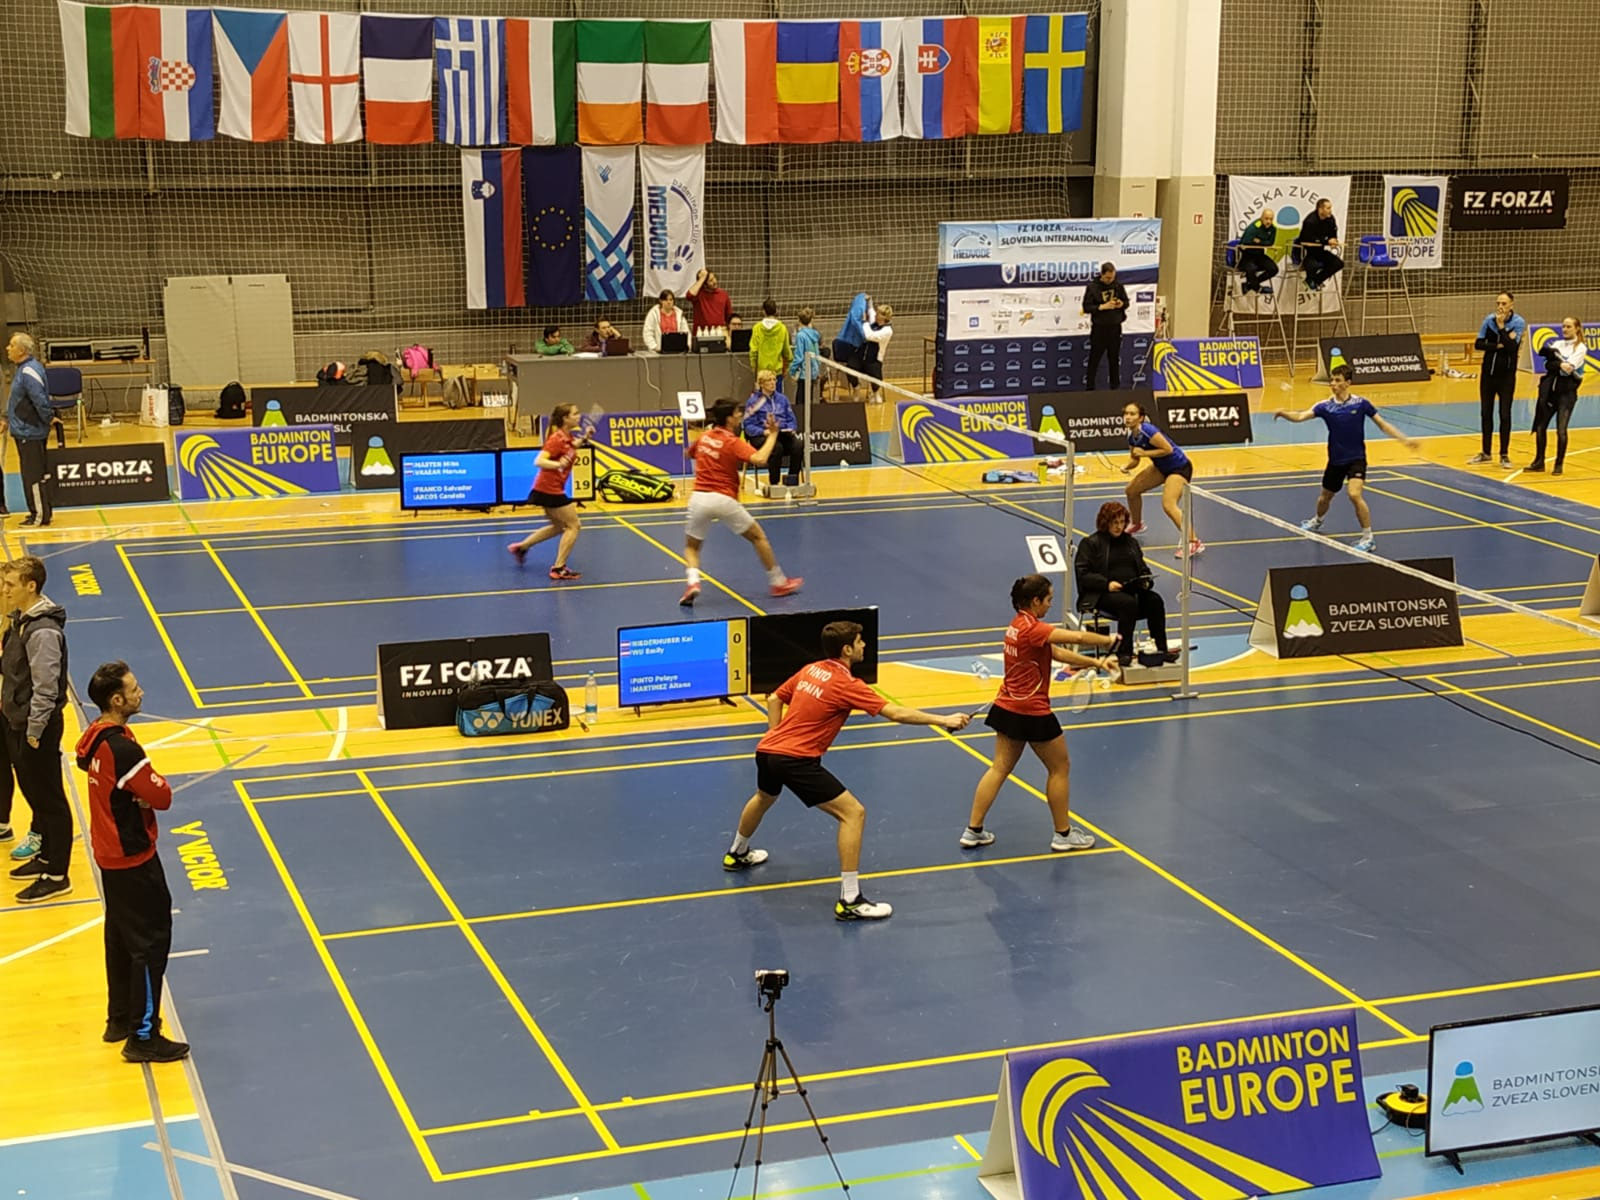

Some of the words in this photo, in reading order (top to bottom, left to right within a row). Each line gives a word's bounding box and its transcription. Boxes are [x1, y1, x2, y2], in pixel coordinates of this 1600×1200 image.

[1289, 185, 1319, 205] ZVE
[1464, 191, 1485, 208] FZ
[1491, 190, 1553, 208] FORZA
[647, 185, 668, 270] MEDVODE
[1018, 224, 1029, 233] FZ
[1031, 223, 1061, 232] FORZA
[1001, 235, 1042, 245] SLOVENIA
[1044, 234, 1110, 243] INTERNATIONAL
[1391, 245, 1435, 258] EUROPE
[1020, 261, 1100, 283] MEDVODE
[1199, 341, 1257, 352] BADMINTON
[1200, 351, 1258, 367] EUROPE
[1352, 355, 1420, 366] BADMINTONSKA
[1355, 366, 1381, 374] ZVEZA
[685, 398, 699, 414] 5
[1168, 409, 1186, 422] FZ
[1189, 407, 1240, 421] FORZA
[295, 412, 389, 423] BADMINTONSKA
[609, 415, 684, 428] BADMINTON
[961, 413, 1028, 432] EUROPE
[250, 430, 331, 445] BADMINTON
[610, 428, 684, 447] EUROPE
[1069, 428, 1101, 438] ZVEZA
[251, 443, 333, 465] EUROPE
[574, 456, 590, 466] 20
[57, 464, 81, 480] FZ
[86, 460, 153, 478] FORZA
[575, 480, 590, 490] 19
[1038, 543, 1058, 565] 6
[1328, 598, 1448, 616] BADMINTONSKA
[1330, 620, 1376, 633] ZVEZA
[1378, 614, 1450, 630] SLOVENIJE
[733, 633, 741, 644] 0
[400, 664, 432, 687] FZ
[440, 657, 533, 683] FORZA
[734, 669, 741, 680] 1
[807, 665, 833, 683] PINTO
[402, 689, 454, 698] INNOVATED
[796, 679, 824, 699] SPAIN
[509, 707, 563, 728] YONEX
[176, 837, 228, 891] VICTOR
[1176, 1025, 1351, 1074] BADMINTON
[1492, 1065, 1600, 1090] BADMINTONS
[1181, 1058, 1357, 1124] EUROPE
[1491, 1091, 1539, 1107] ZVEZA
[1543, 1083, 1600, 1100] SLOVEN
